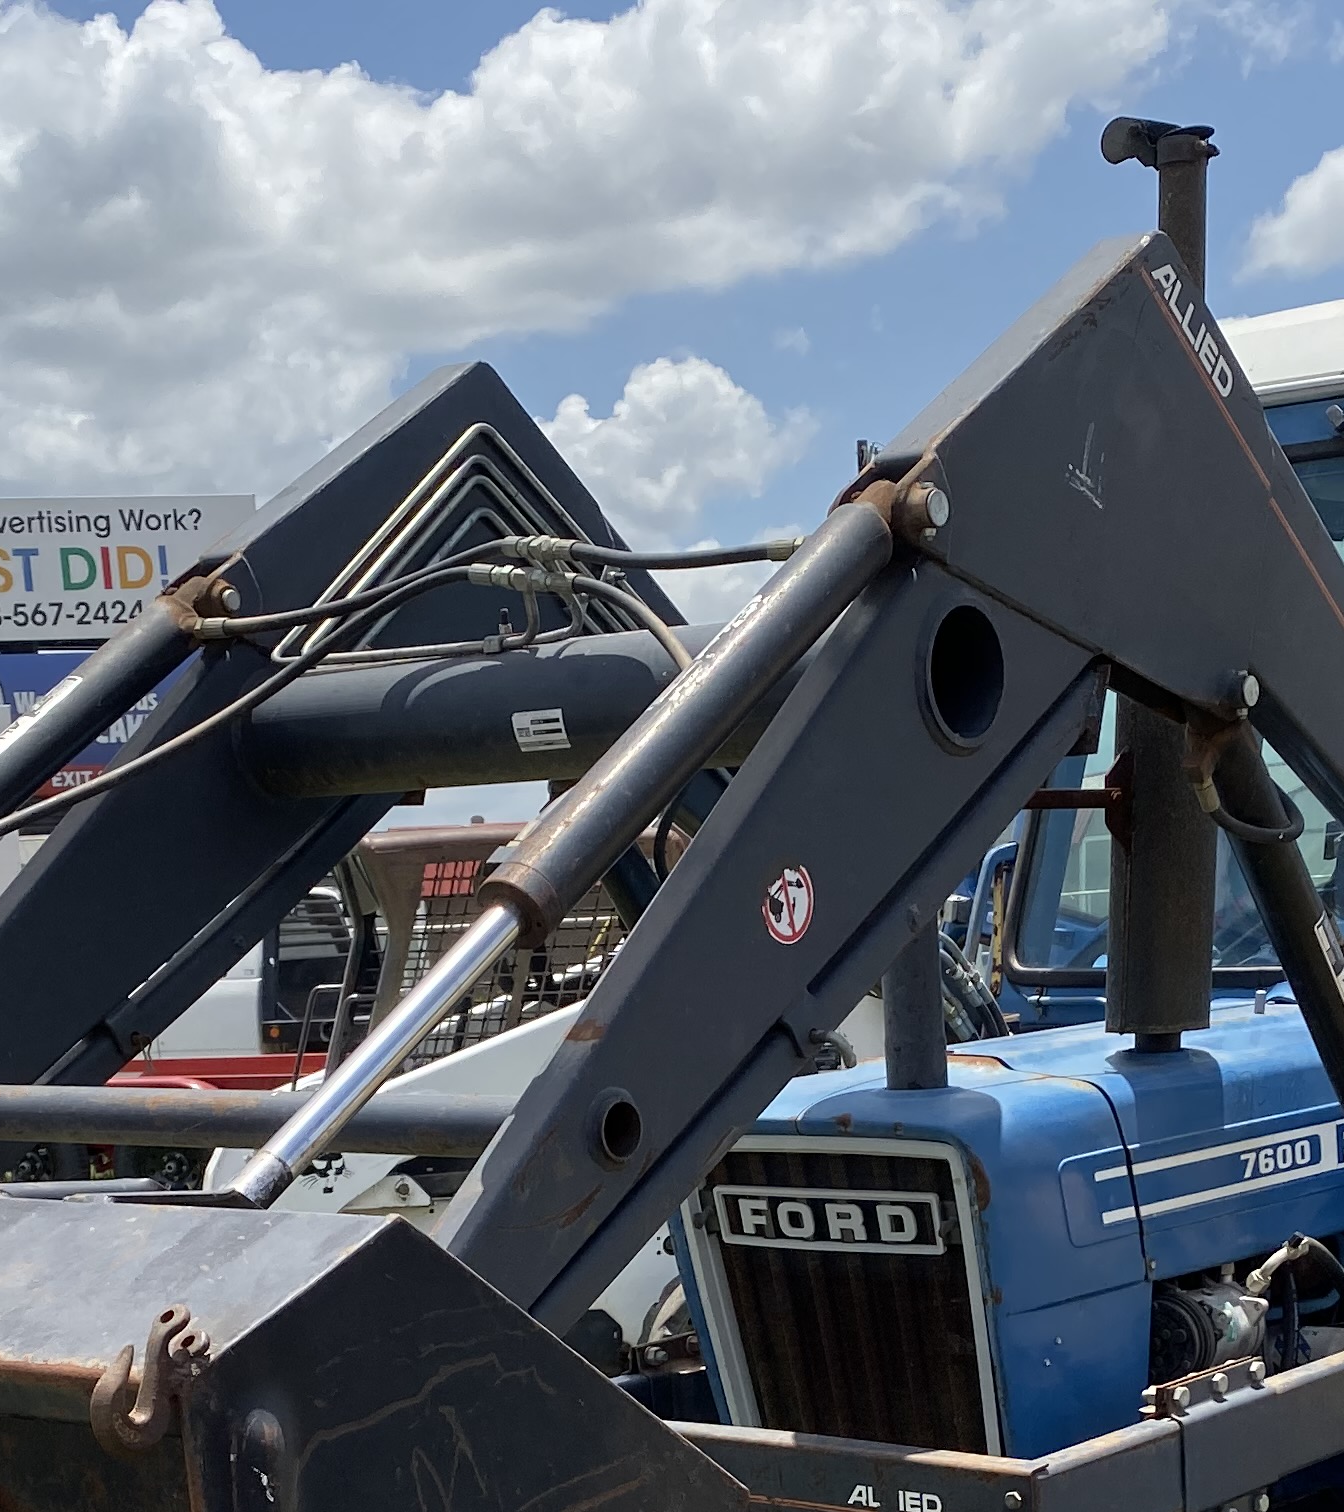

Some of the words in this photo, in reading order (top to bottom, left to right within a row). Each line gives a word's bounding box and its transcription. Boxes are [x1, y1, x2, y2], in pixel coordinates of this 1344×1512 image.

[1150, 263, 1235, 398] ALLIED
[119, 507, 202, 532] Work?
[60, 544, 170, 591] DID!
[50, 769, 94, 788] EXIT
[1239, 1138, 1313, 1180] 7600
[737, 1197, 919, 1244] FORD
